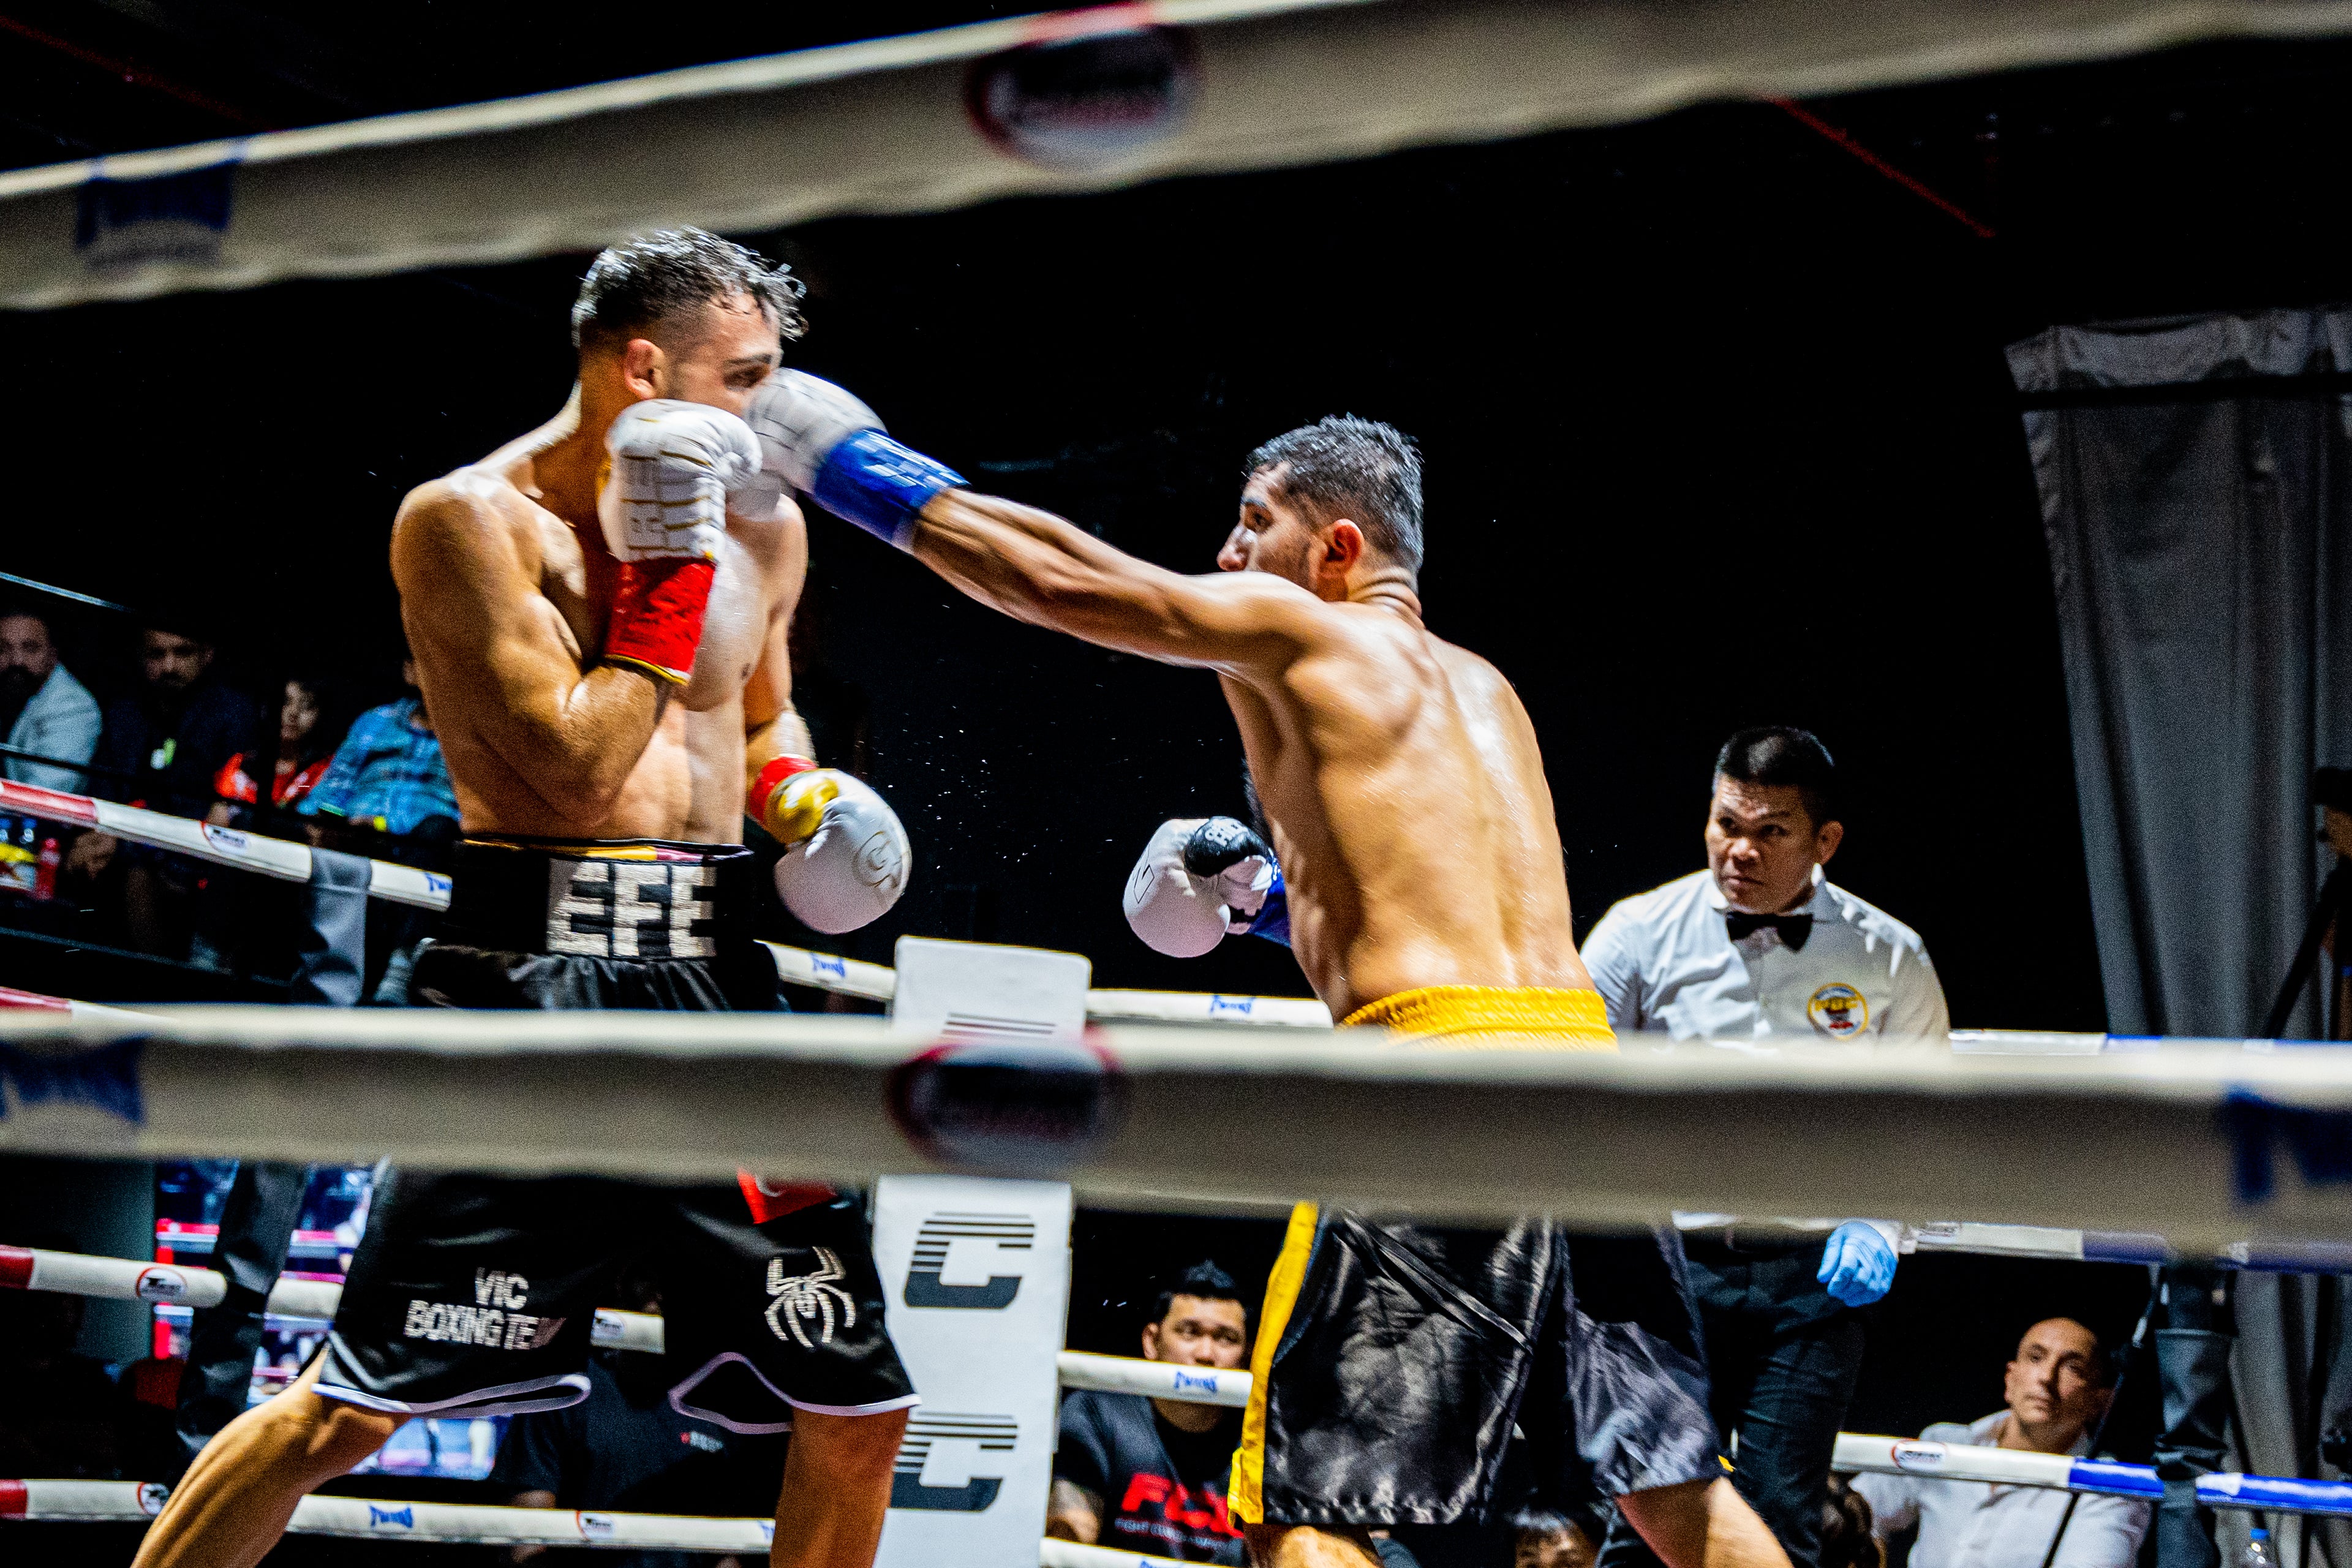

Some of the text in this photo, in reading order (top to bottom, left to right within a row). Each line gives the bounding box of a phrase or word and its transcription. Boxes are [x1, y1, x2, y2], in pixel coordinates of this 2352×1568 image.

[546, 858, 717, 957] EFE
[475, 1267, 529, 1310] VIC
[404, 1299, 504, 1348] BOXING
